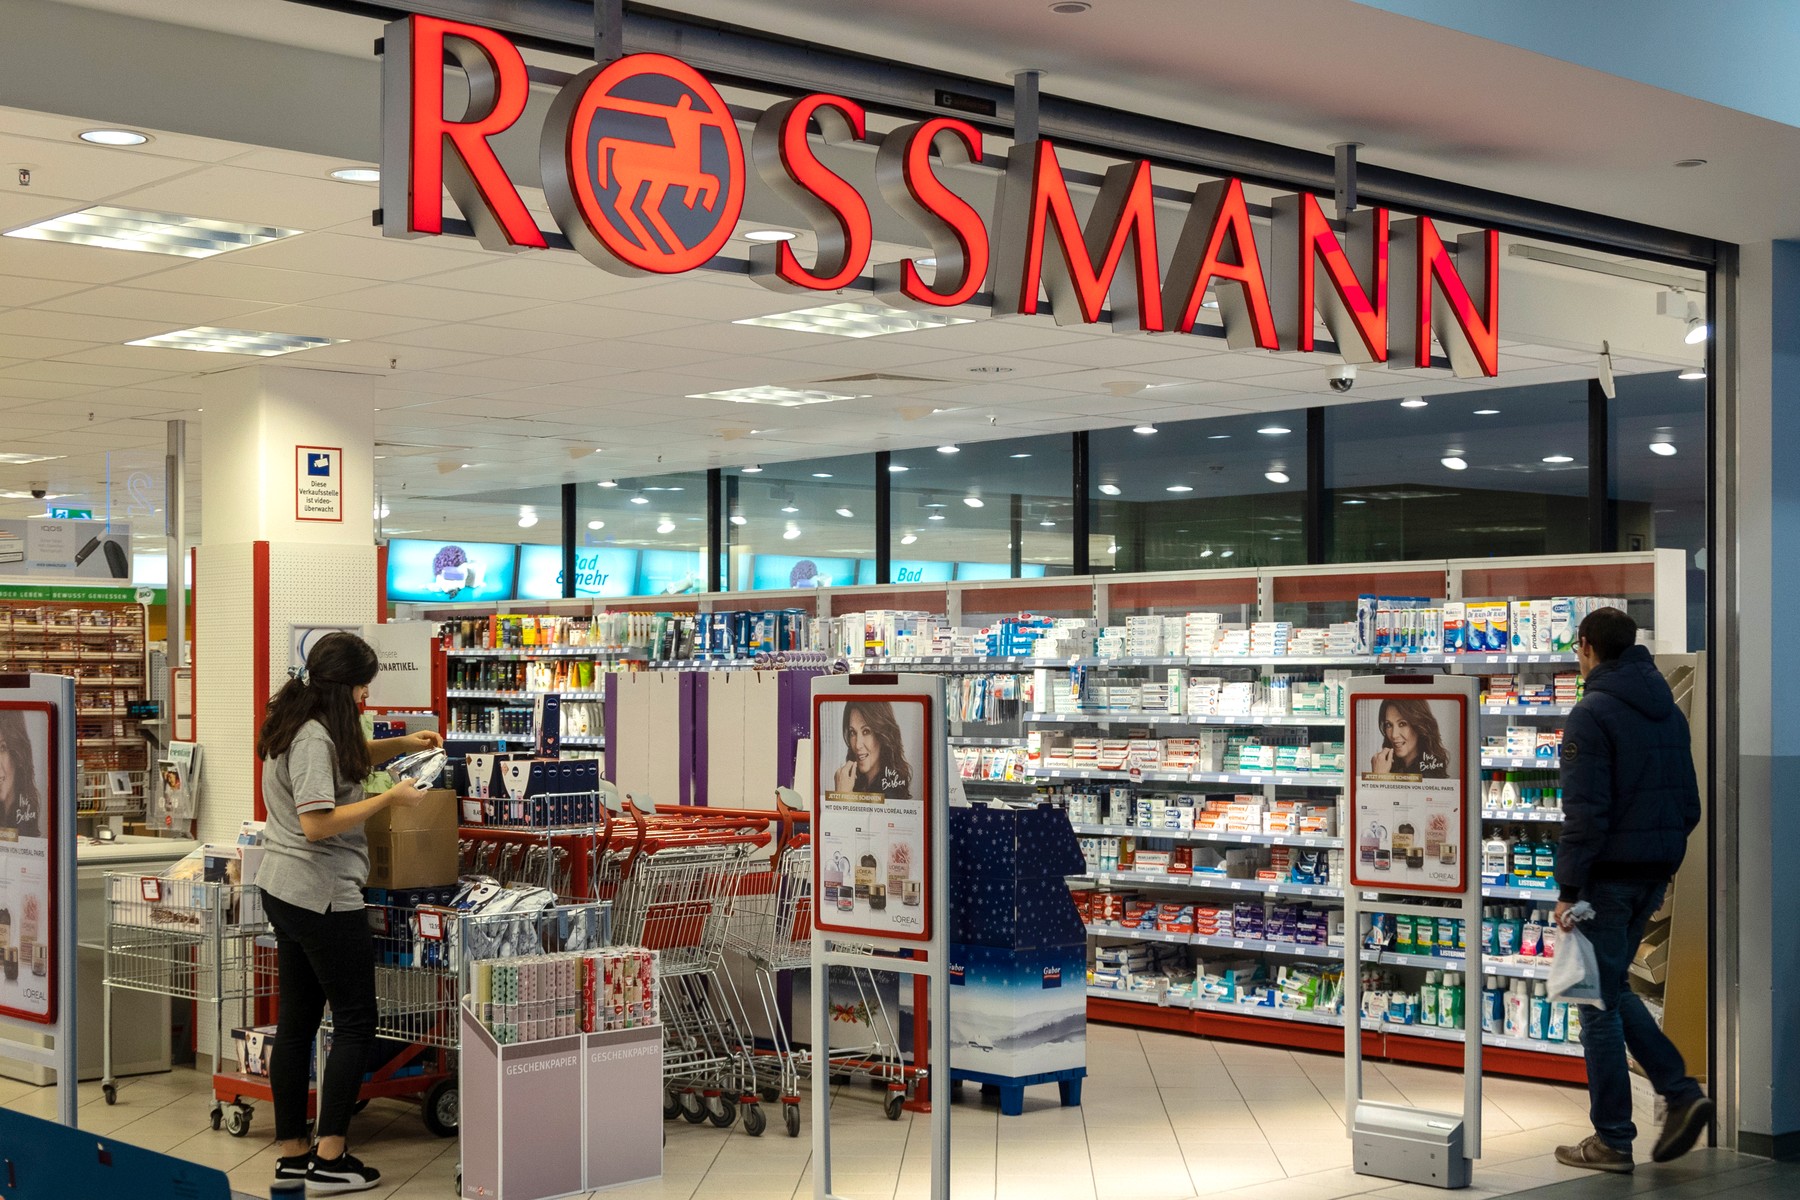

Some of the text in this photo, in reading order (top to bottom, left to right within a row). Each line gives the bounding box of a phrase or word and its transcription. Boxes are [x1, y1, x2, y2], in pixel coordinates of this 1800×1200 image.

[410, 14, 1500, 378] ROSSMANN
[575, 554, 598, 570] ad
[897, 567, 923, 582] Bad
[379, 662, 418, 671] ONARTIKEL.
[1043, 966, 1061, 975] Gabor
[591, 1045, 659, 1063] GESCHENKPAPIER
[506, 1056, 577, 1076] GESCHENKPAPIER
